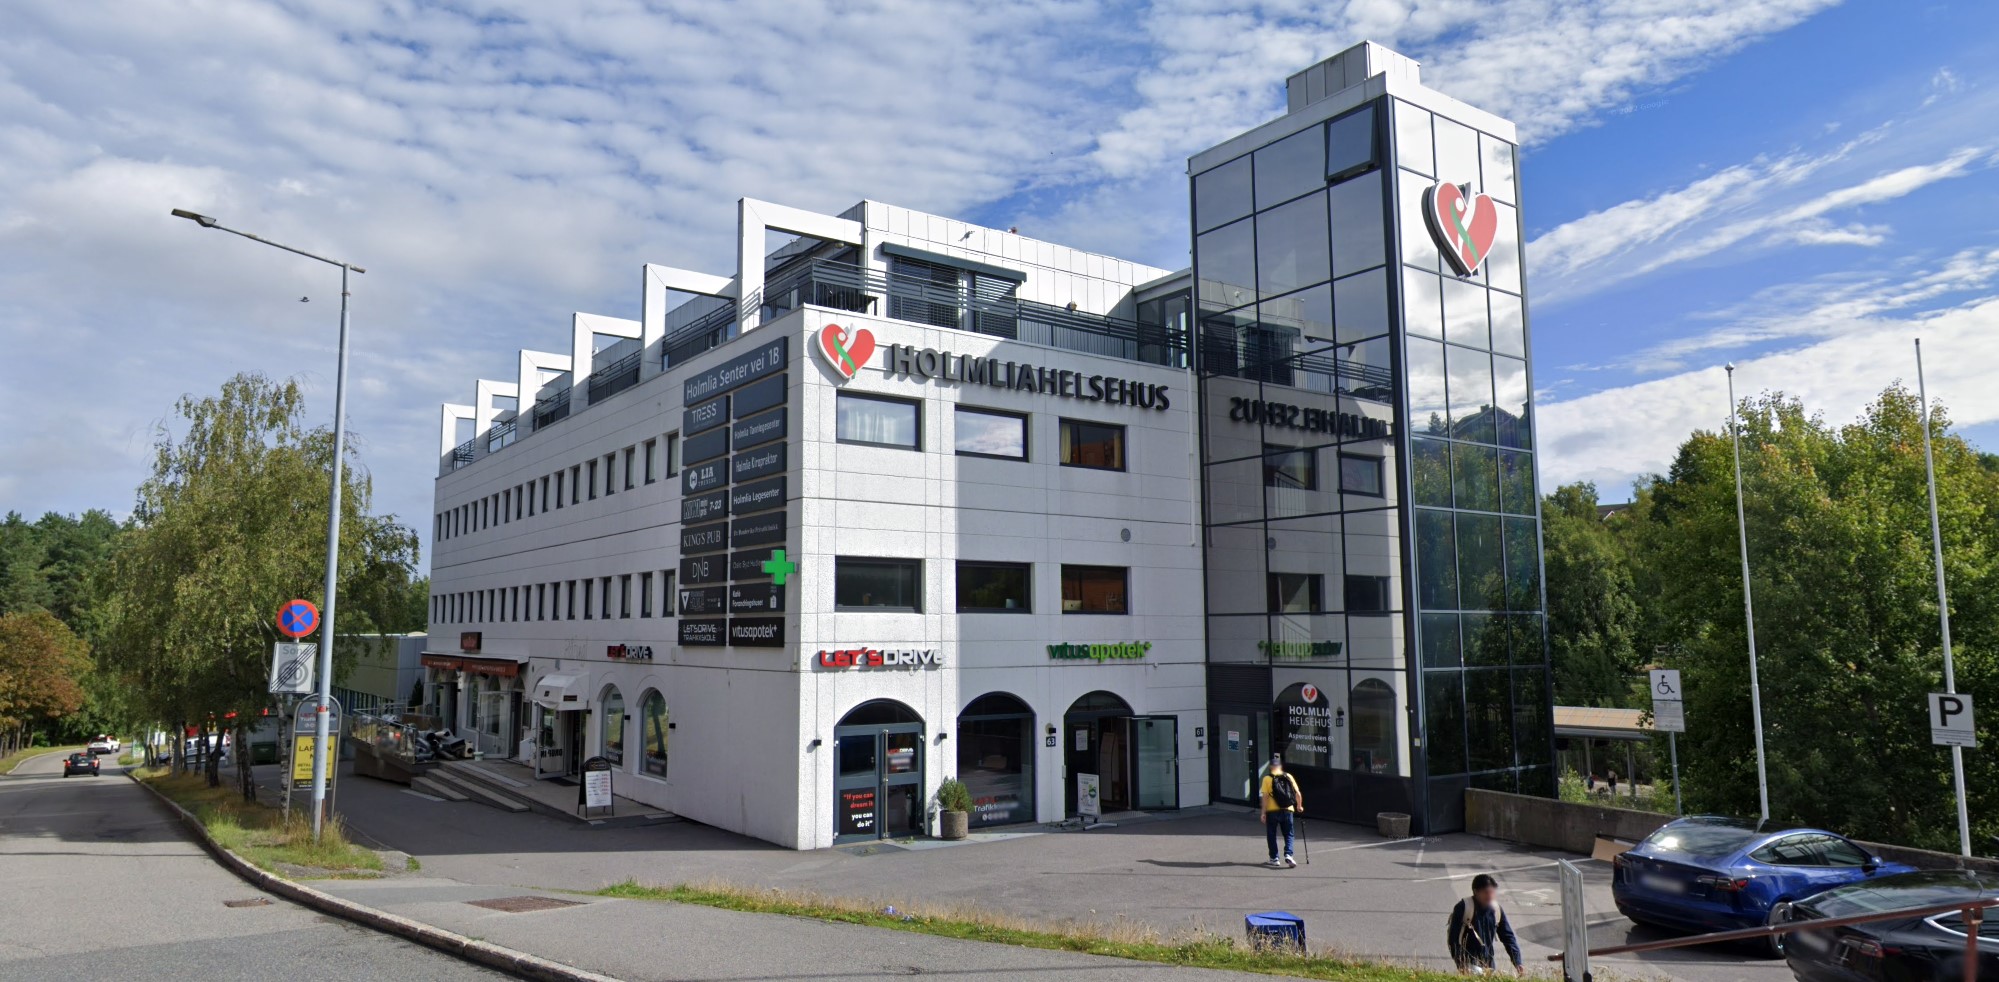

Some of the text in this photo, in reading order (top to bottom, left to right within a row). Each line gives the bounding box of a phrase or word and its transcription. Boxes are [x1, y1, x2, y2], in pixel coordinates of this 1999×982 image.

[686, 346, 780, 400] Holmlia Senter vei 1B
[891, 343, 1170, 411] HOLMLIAHELSEHUS
[692, 403, 717, 423] TRESS
[735, 428, 749, 440] Holmlia
[701, 467, 714, 480] LIA
[733, 488, 780, 505] Holmlia Legesenter
[706, 530, 721, 544] PUB
[692, 557, 709, 582] DNB
[1288, 705, 1331, 717] HOLMLIA
[1938, 696, 1964, 727] P
[1289, 716, 1332, 728] HELSEHUS
[1047, 737, 1056, 747] 63
[1288, 732, 1327, 742] Asperudveien
[1295, 744, 1328, 754] INNGANG
